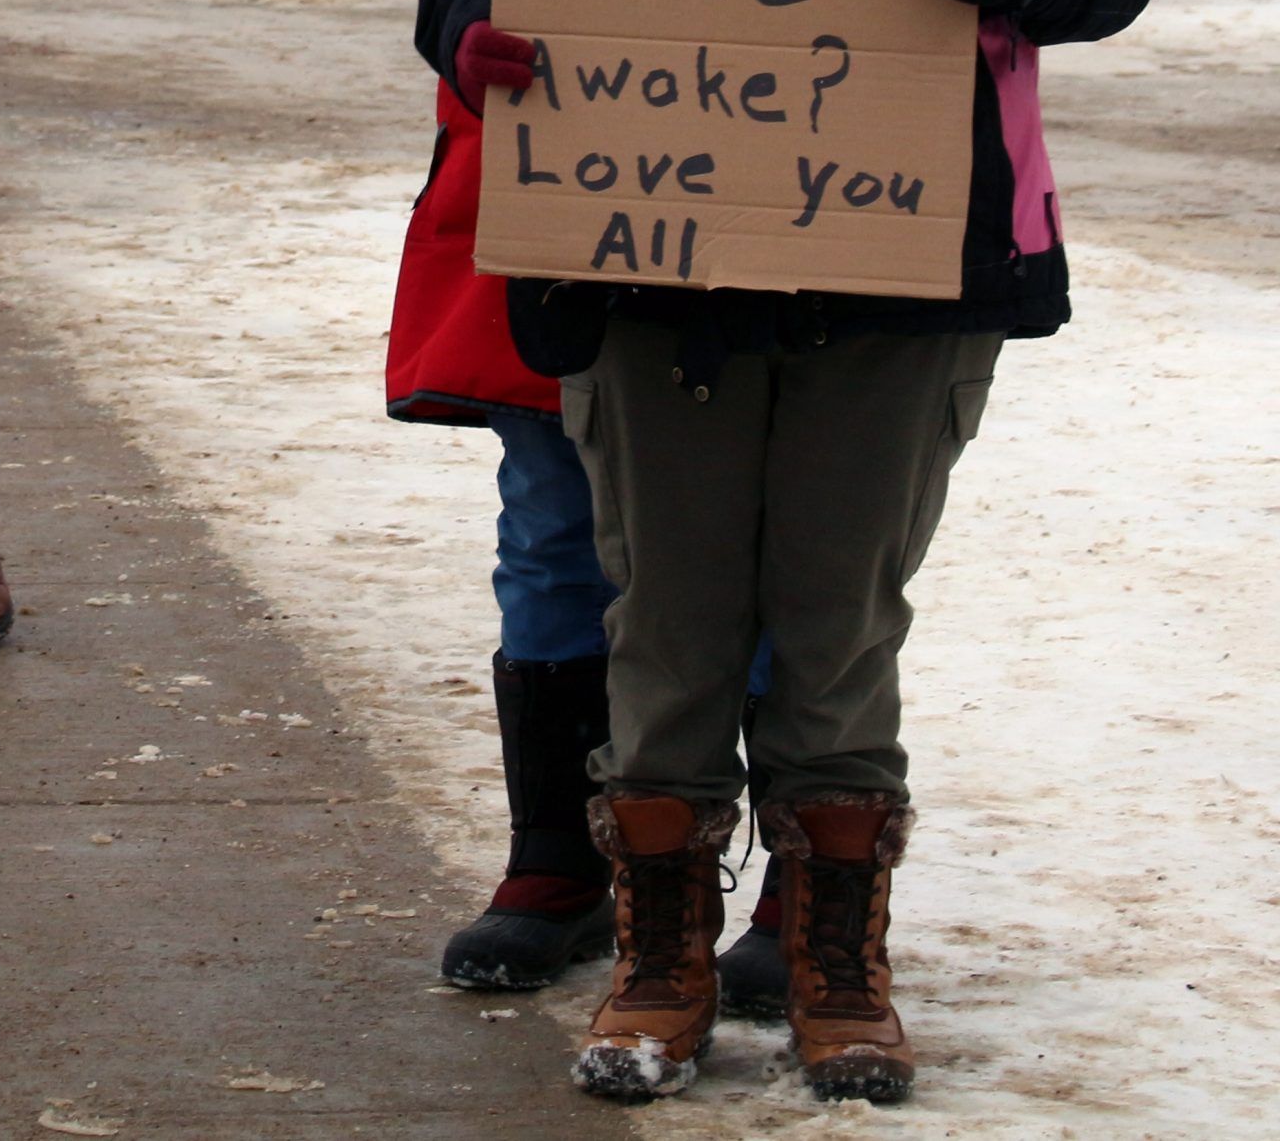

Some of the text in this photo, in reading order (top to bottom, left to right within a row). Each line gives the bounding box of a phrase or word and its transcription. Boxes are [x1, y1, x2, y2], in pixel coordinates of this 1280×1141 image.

[508, 34, 851, 134] Awoke?
[516, 122, 925, 227] Love you
[591, 211, 697, 282] All
